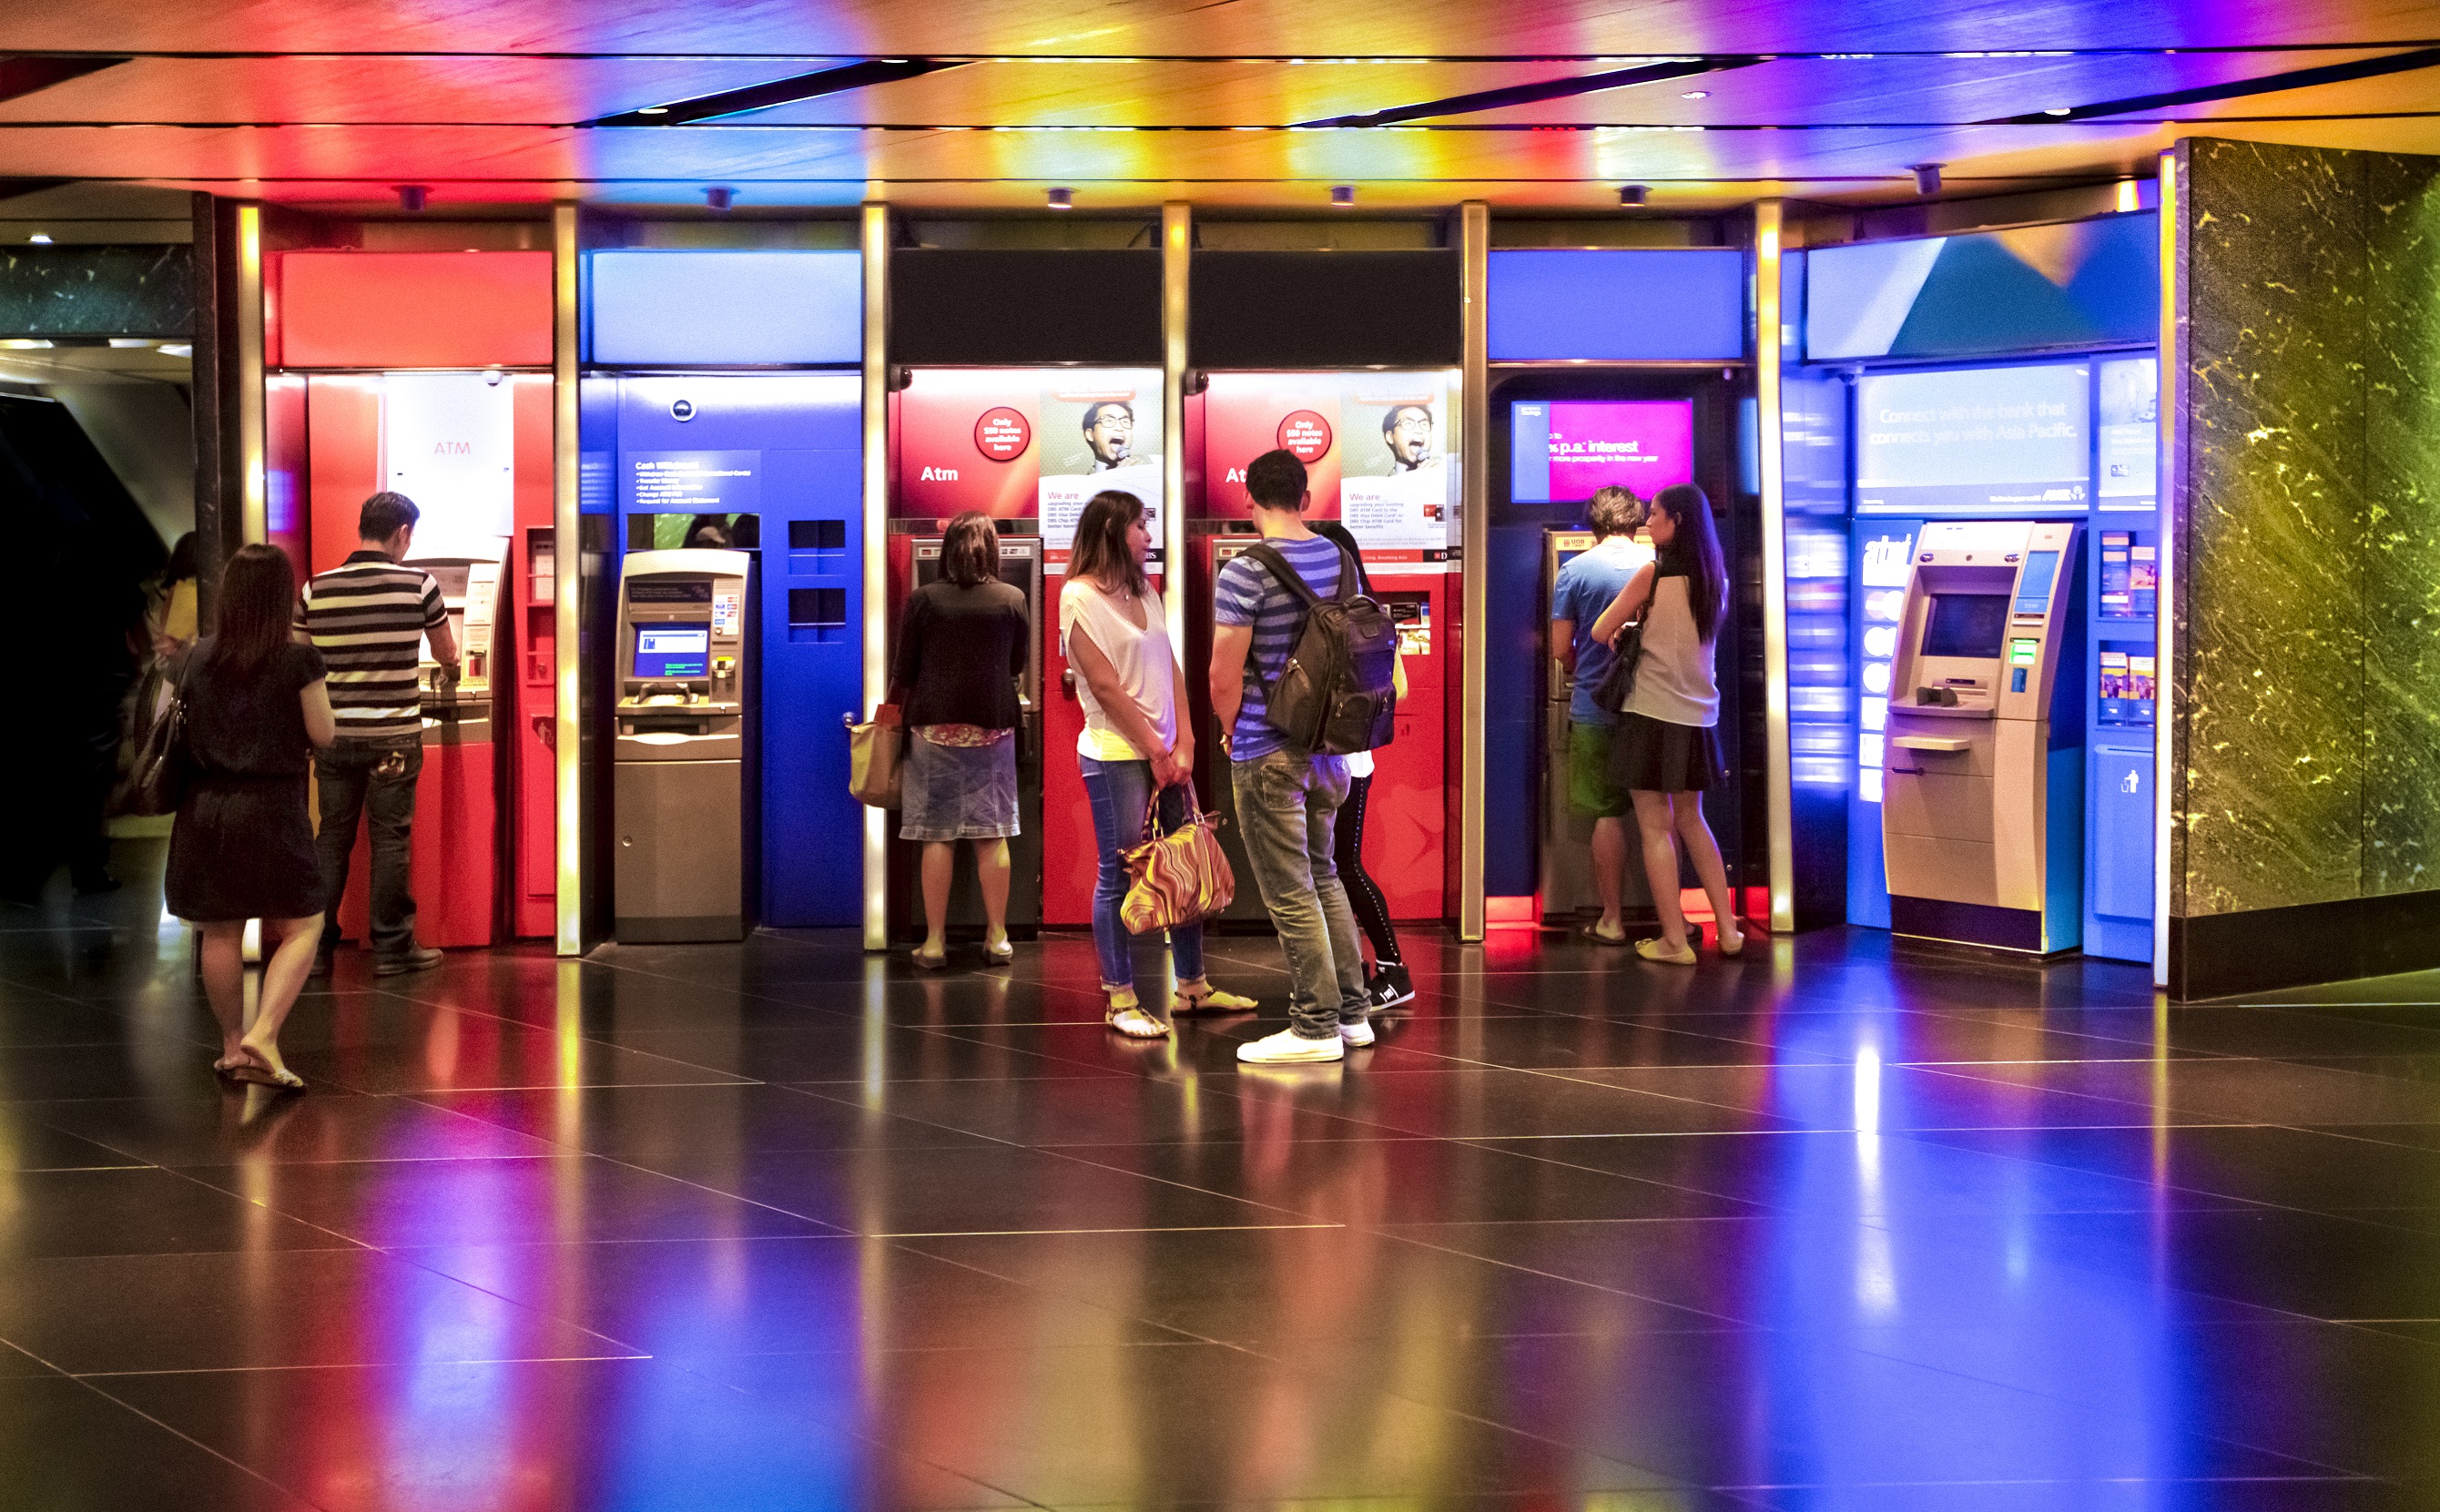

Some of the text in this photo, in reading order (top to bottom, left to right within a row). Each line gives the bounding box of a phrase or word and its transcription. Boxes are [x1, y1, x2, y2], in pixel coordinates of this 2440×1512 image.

[1879, 401, 2066, 423] Connect with the bank that
[992, 418, 1012, 428] Only
[1296, 421, 1314, 430] Only
[1869, 431, 1931, 444] connects
[1962, 425, 1994, 441] with
[1995, 424, 2026, 440] Asia
[2028, 421, 2078, 438] Pacific.
[434, 441, 471, 455] ATM
[1588, 440, 1639, 452] interest
[635, 462, 656, 470] Cash
[920, 465, 959, 482] Atm
[1225, 467, 1246, 483] At
[2041, 489, 2071, 501] ANZ
